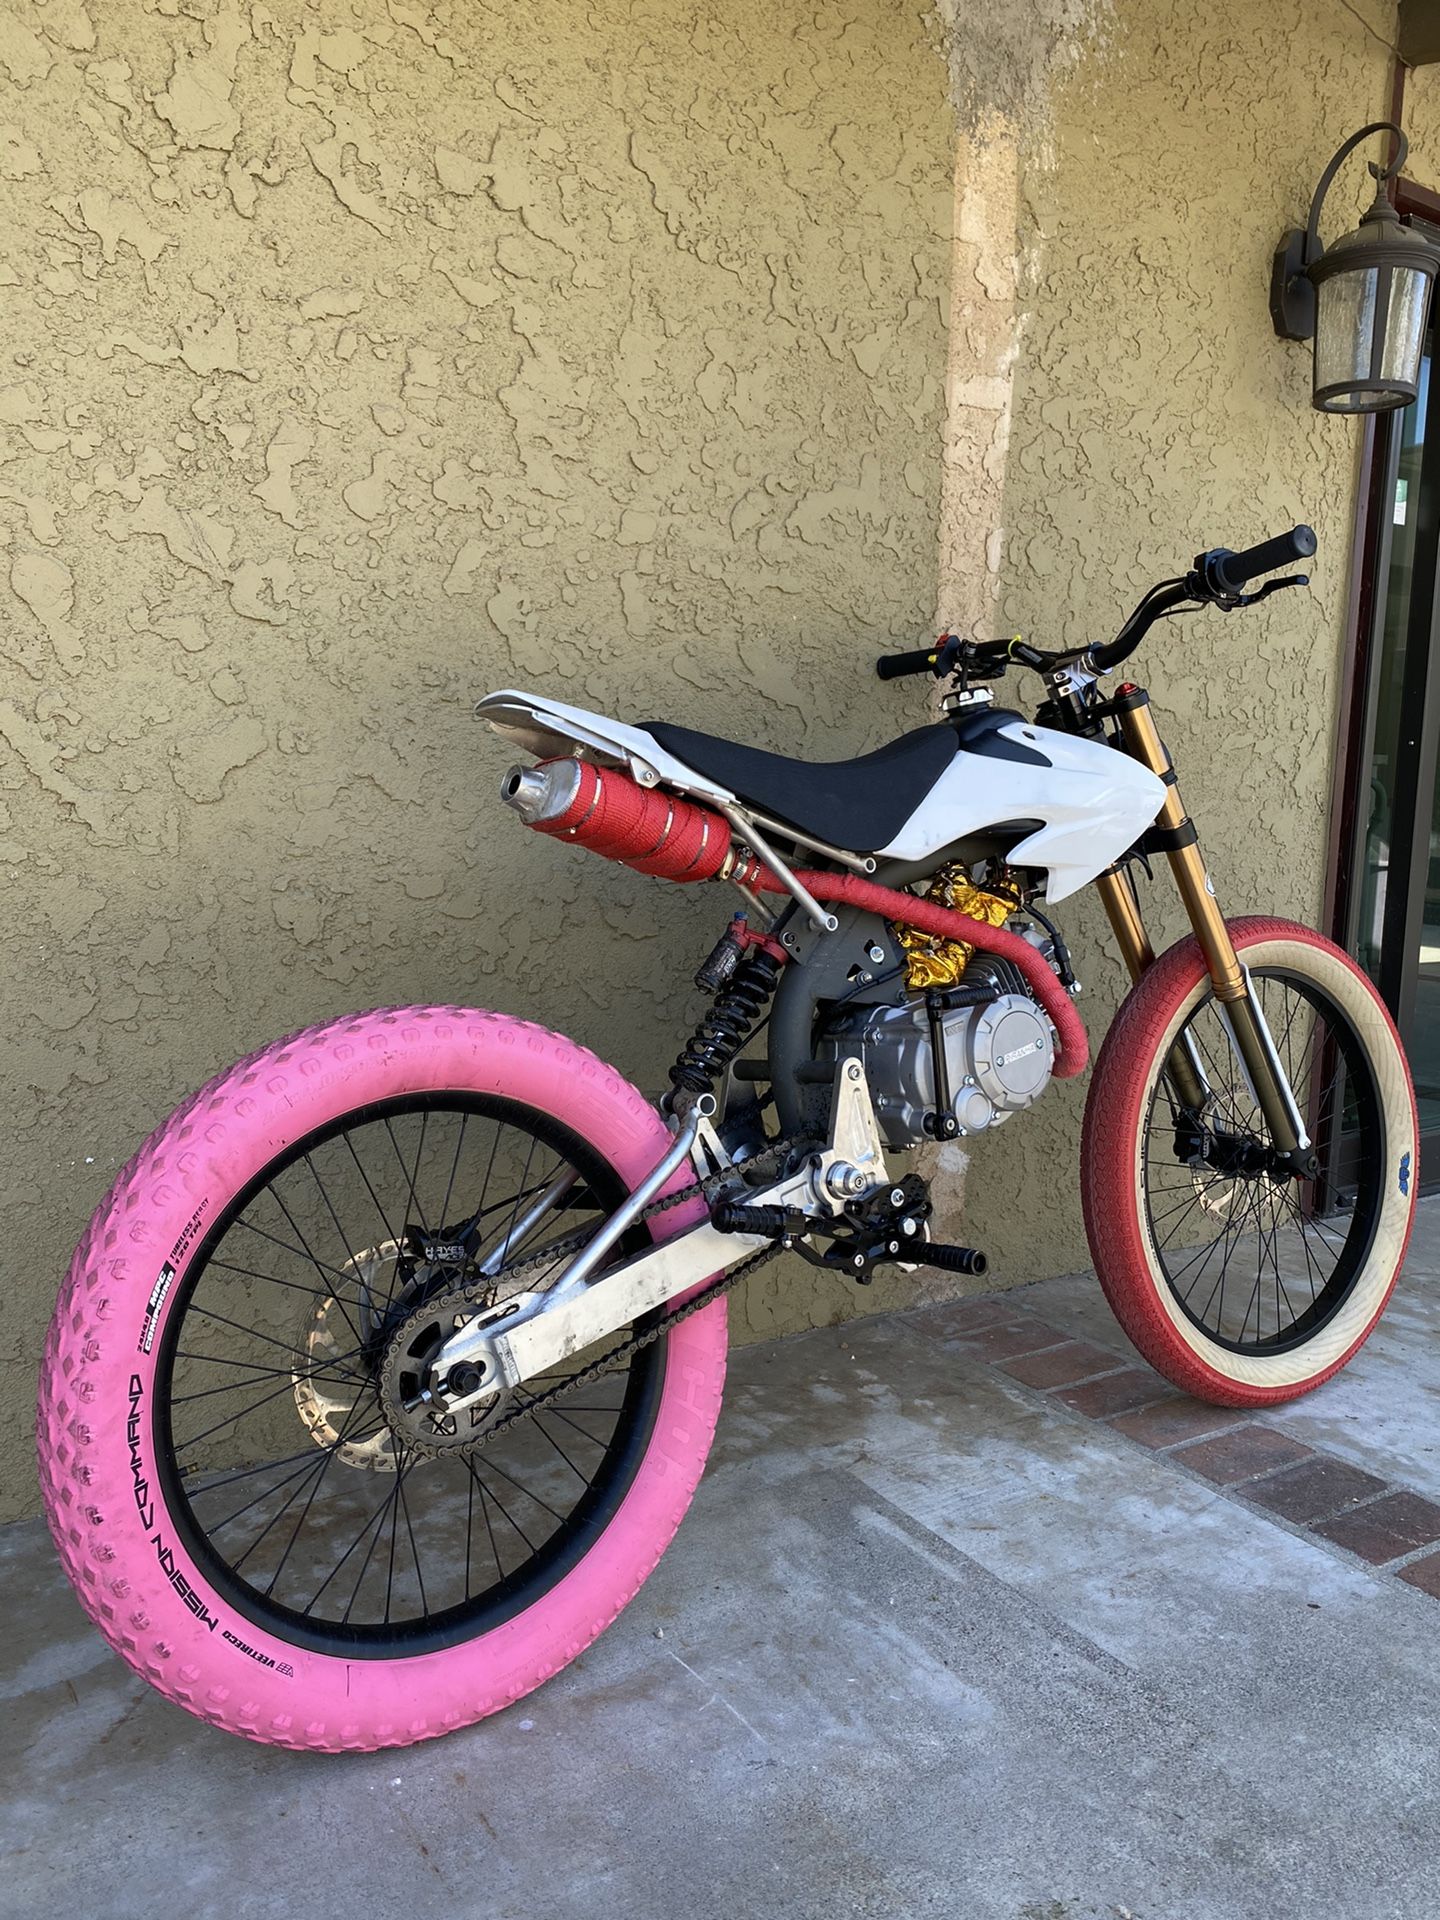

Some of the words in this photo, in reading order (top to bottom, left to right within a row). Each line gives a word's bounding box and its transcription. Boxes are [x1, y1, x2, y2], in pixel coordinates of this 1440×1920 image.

[170, 1221, 193, 1259] TUBELESS
[175, 1240, 189, 1264] 120
[189, 1220, 202, 1239] TPI
[425, 1246, 464, 1254] HAYES
[144, 1270, 175, 1351] COMPOUND
[149, 1270, 167, 1308] MPC
[127, 1374, 153, 1531] COMMAND
[150, 1533, 219, 1632] MISSION
